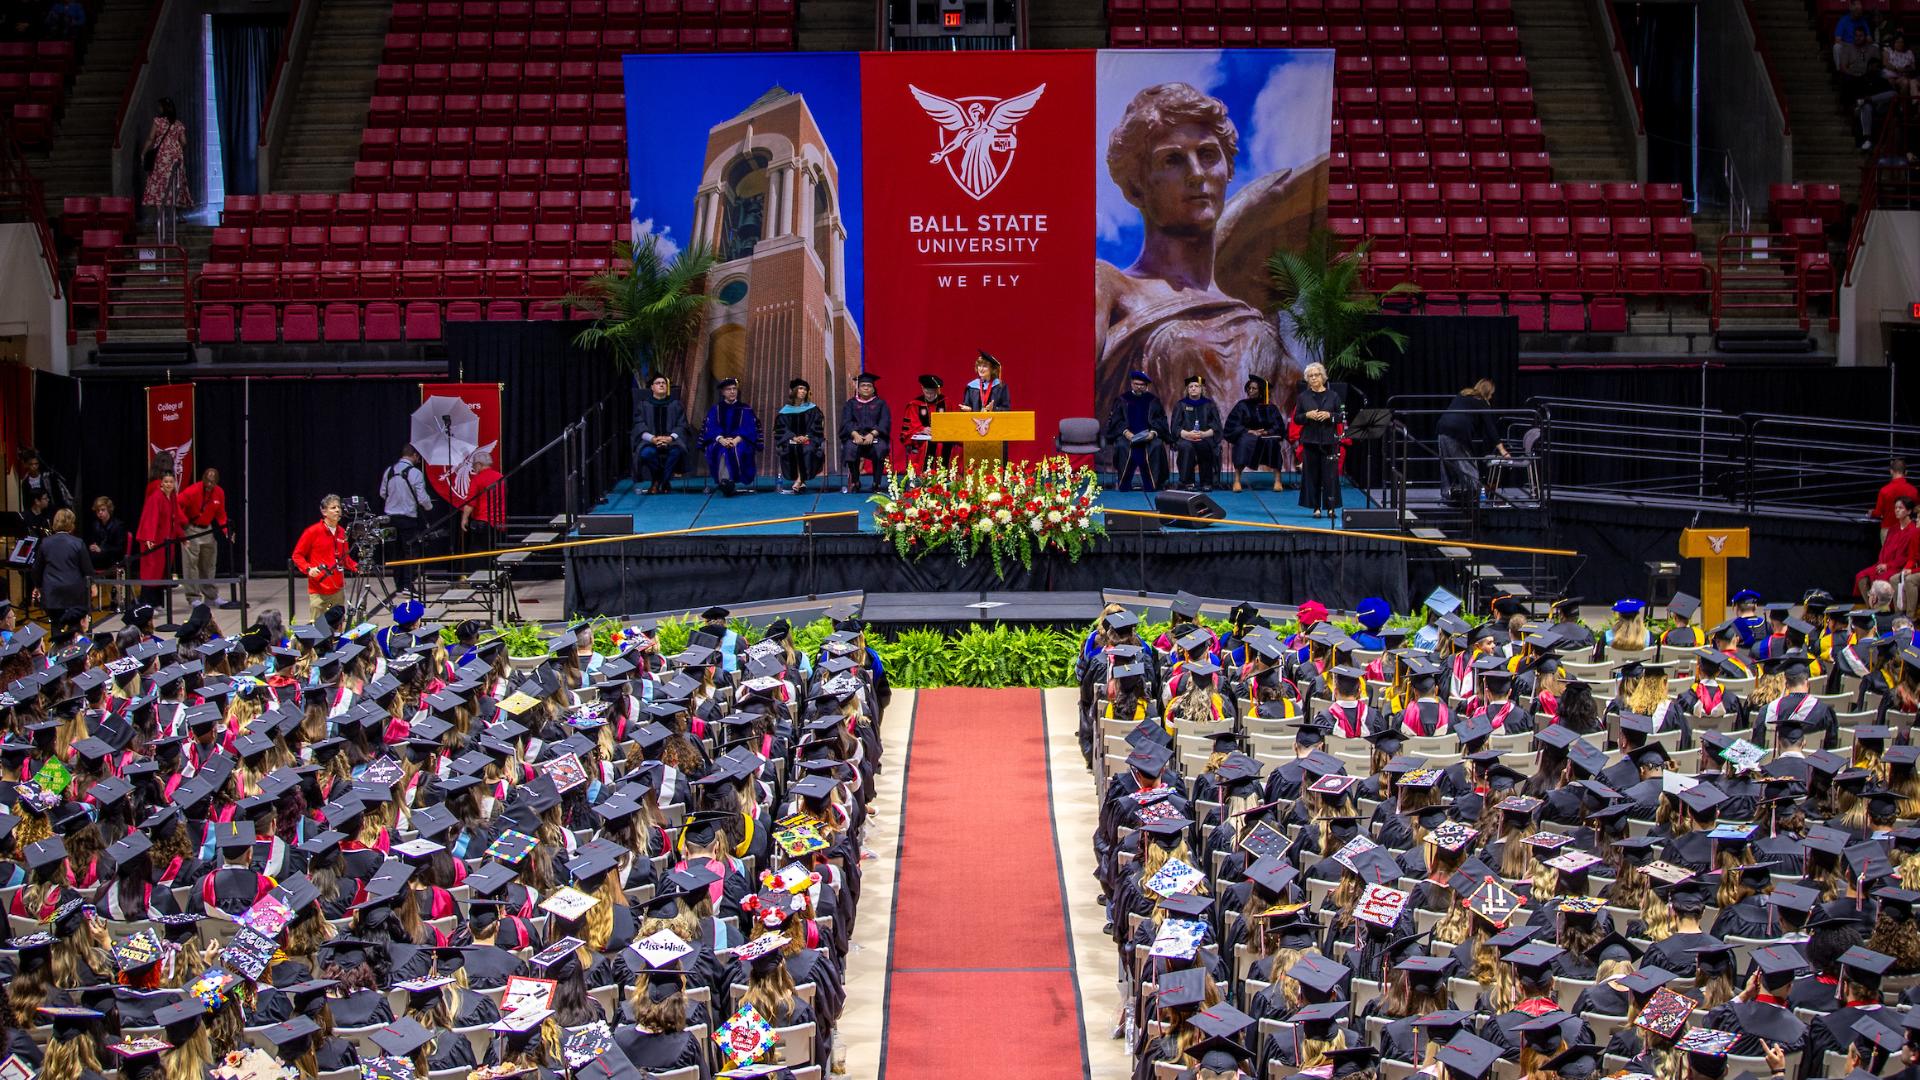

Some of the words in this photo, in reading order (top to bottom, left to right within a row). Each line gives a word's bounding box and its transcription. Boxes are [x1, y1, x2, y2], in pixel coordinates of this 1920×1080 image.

[945, 13, 960, 26] EXIT
[910, 215, 968, 233] BALL
[978, 214, 1048, 232] STATE
[917, 237, 1040, 253] UNIVERSITY
[938, 275, 967, 288] WE
[983, 274, 1020, 287] FLY
[638, 940, 659, 951] Miss
